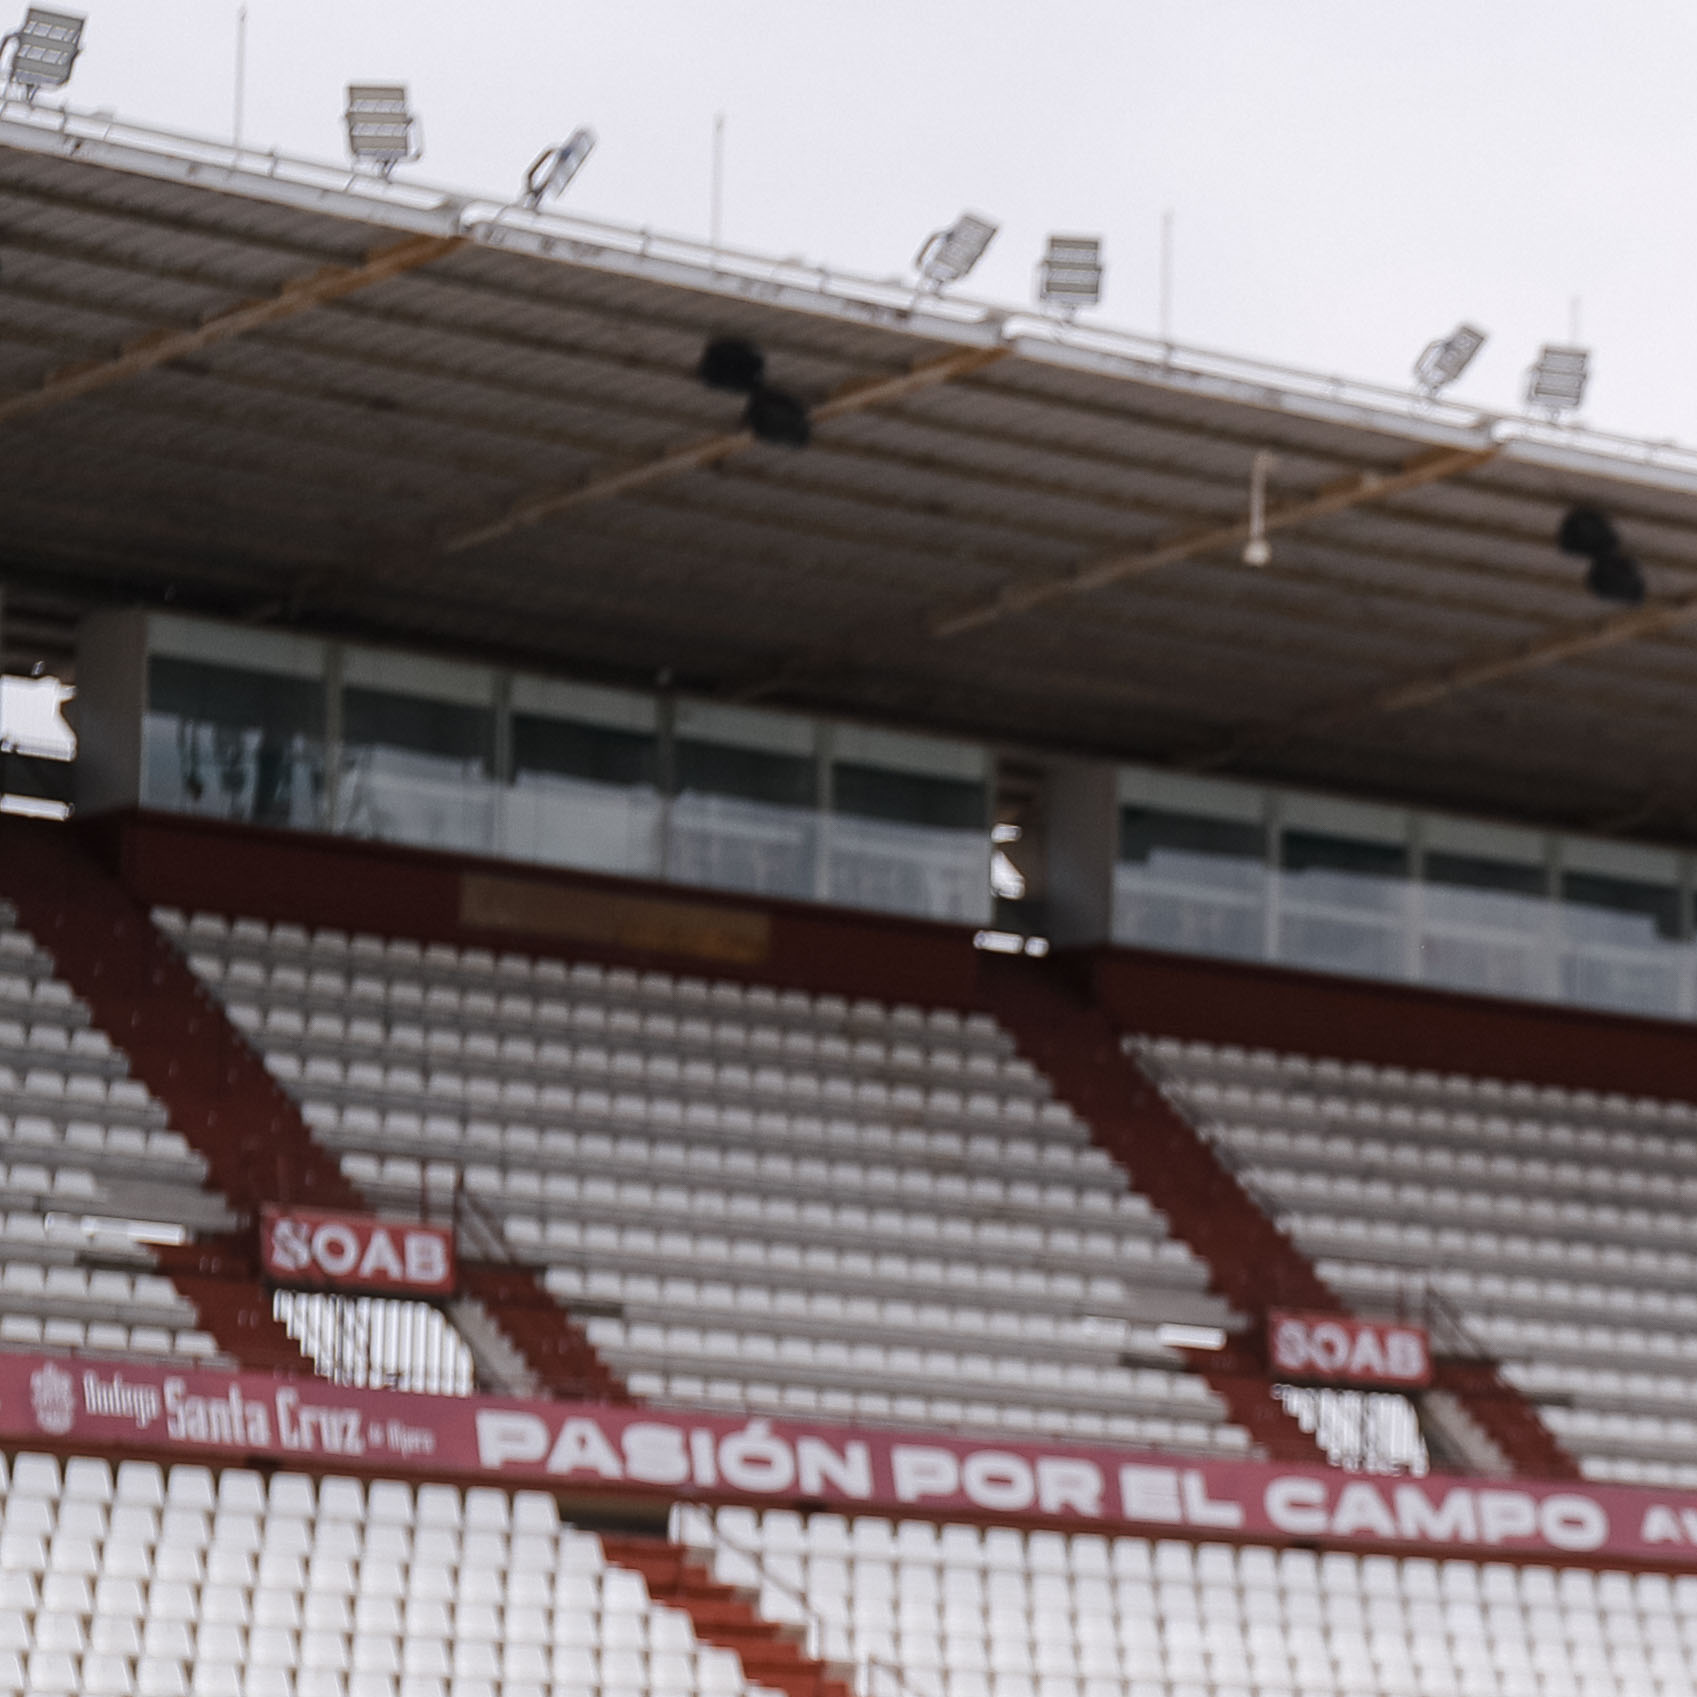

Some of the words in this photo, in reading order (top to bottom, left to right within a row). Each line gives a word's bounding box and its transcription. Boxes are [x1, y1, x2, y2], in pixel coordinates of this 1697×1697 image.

[164, 1376, 270, 1448] Santa
[275, 1385, 365, 1455] Cruz
[475, 1407, 873, 1499] PASIÓN
[890, 1444, 1106, 1518] POR
[1118, 1462, 1246, 1530] EL
[1264, 1476, 1609, 1552] CAMPO
